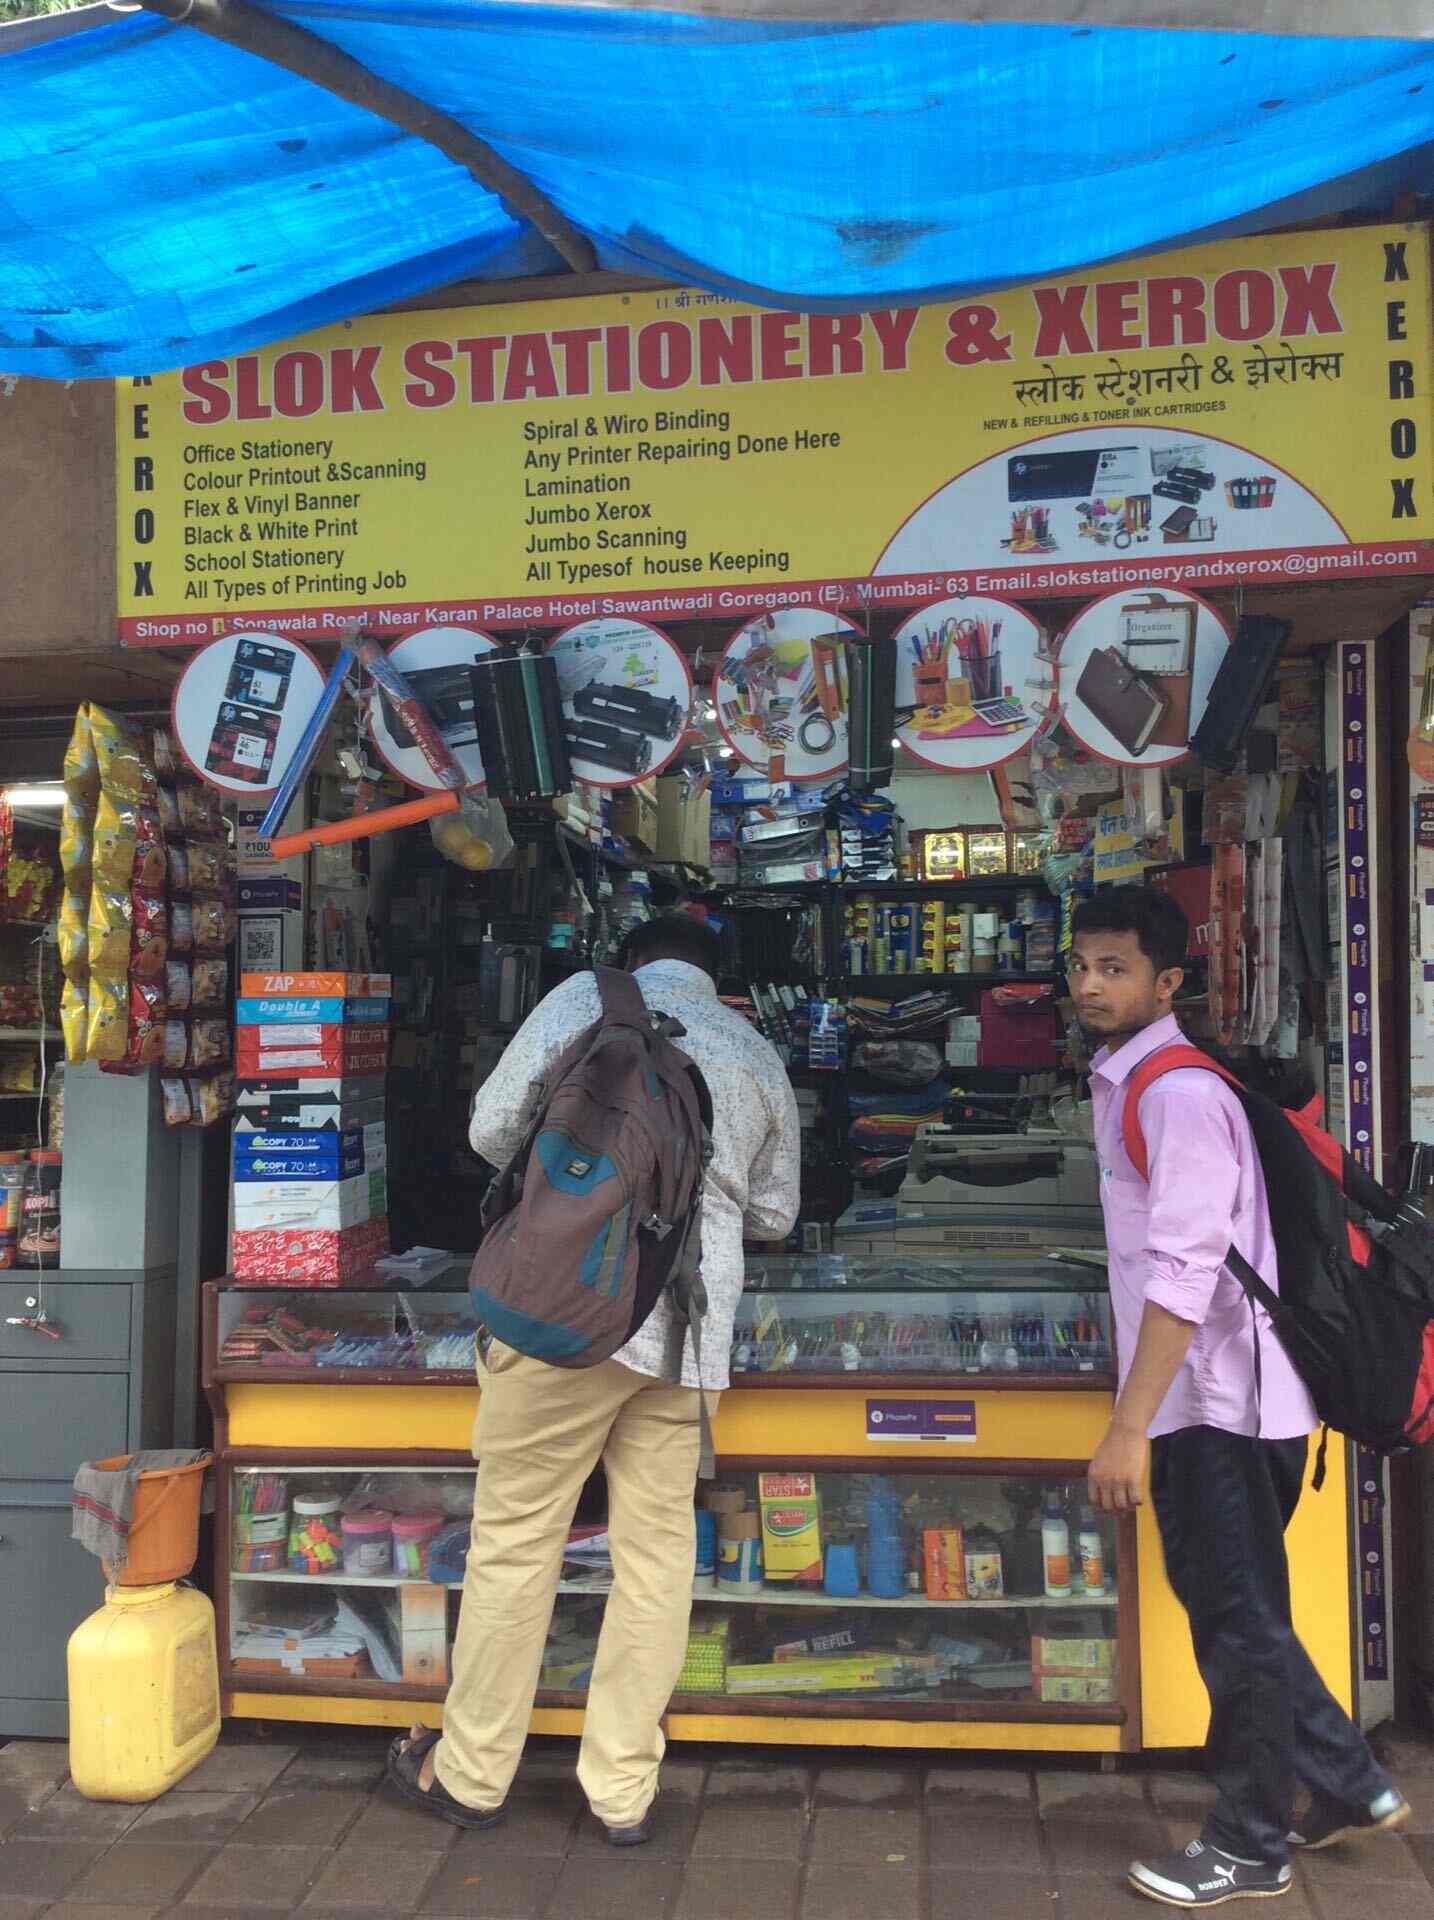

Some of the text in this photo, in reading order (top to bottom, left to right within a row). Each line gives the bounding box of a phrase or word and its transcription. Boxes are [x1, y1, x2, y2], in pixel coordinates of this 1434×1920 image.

[181, 262, 1344, 424] SLOK STATIONERY & XEROX
[1013, 363, 1086, 407] स्लोक
[1212, 355, 1235, 385] &
[1244, 342, 1344, 391] झेरोक्स
[1383, 242, 1418, 519] XEROX
[524, 408, 730, 444] Spiral & Wiro Binding
[983, 400, 1226, 431] NEW & REFILLING & TONER INK CARTRIDGES
[184, 438, 333, 464] Office Stationery
[524, 430, 842, 472] Any Printer Repairing Done Here
[184, 460, 427, 492] Colour Printout &Scanning
[525, 474, 631, 498] Lamination
[185, 491, 361, 519] Flex & Vinyl Banner
[525, 502, 652, 526] Jumbo Xerox
[185, 518, 359, 546] Black & White Print
[525, 527, 687, 554] Jumbo Scanning
[184, 548, 345, 573] School Stationery
[526, 550, 790, 585] All Typesof house Keeping
[185, 569, 407, 601] All Types of Printing Job
[135, 622, 181, 640] Shop
[186, 623, 207, 635] no
[379, 610, 420, 625] Near
[425, 606, 478, 623] Karan
[484, 603, 544, 620] Palace
[550, 600, 597, 616] Hotel
[602, 592, 713, 613] Sawantwadi
[719, 588, 812, 609] Goregaon
[946, 576, 969, 593] 63
[263, 975, 294, 992] ZAP
[258, 1000, 304, 1012] Double
